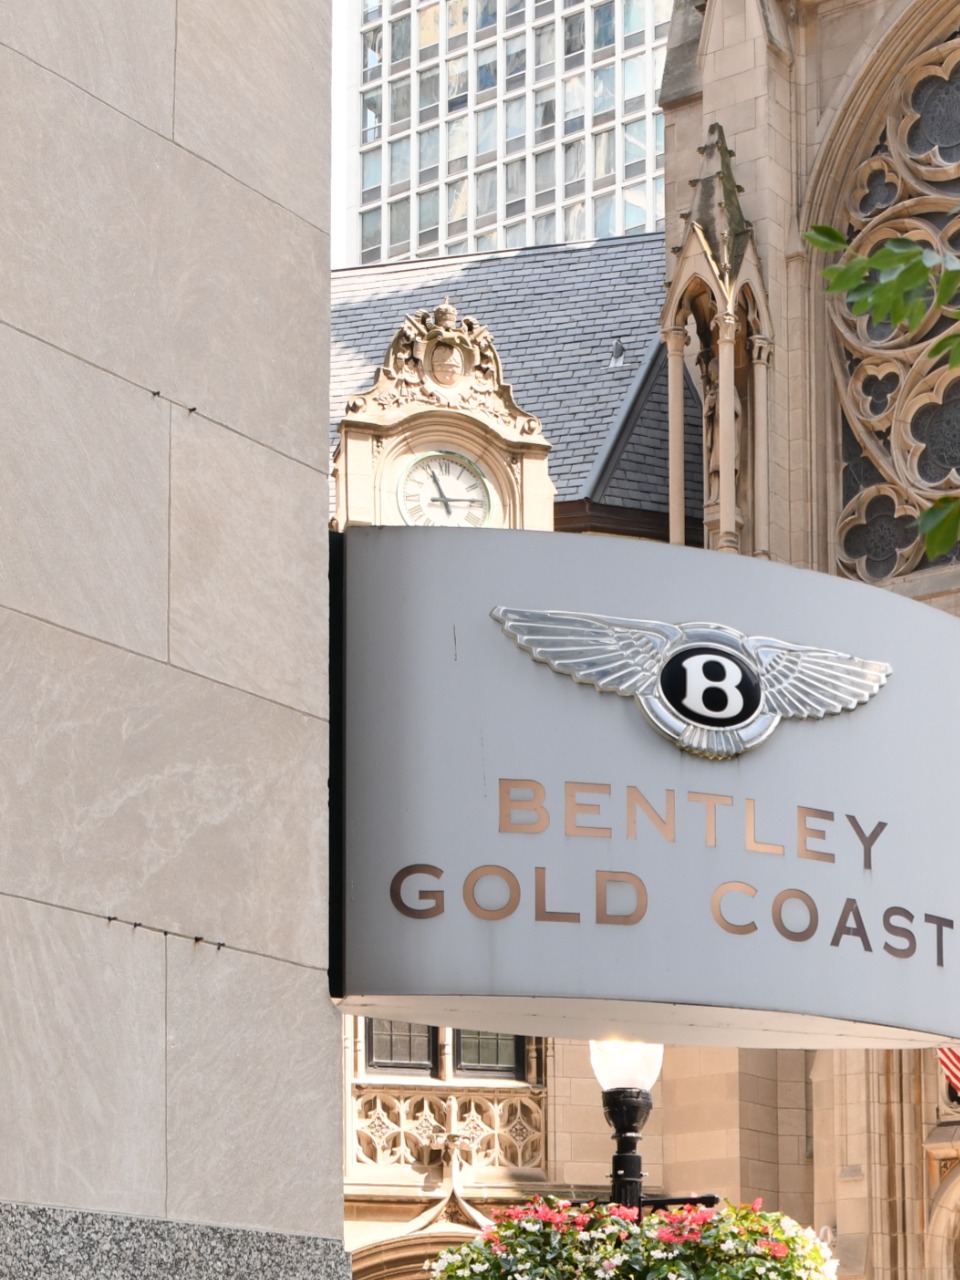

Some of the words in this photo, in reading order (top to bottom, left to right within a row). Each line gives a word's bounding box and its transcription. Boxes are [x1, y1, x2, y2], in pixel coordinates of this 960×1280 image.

[682, 654, 744, 720] B
[498, 778, 888, 870] BENTLEY
[389, 863, 649, 926] GOLD
[710, 881, 955, 967] COAST
